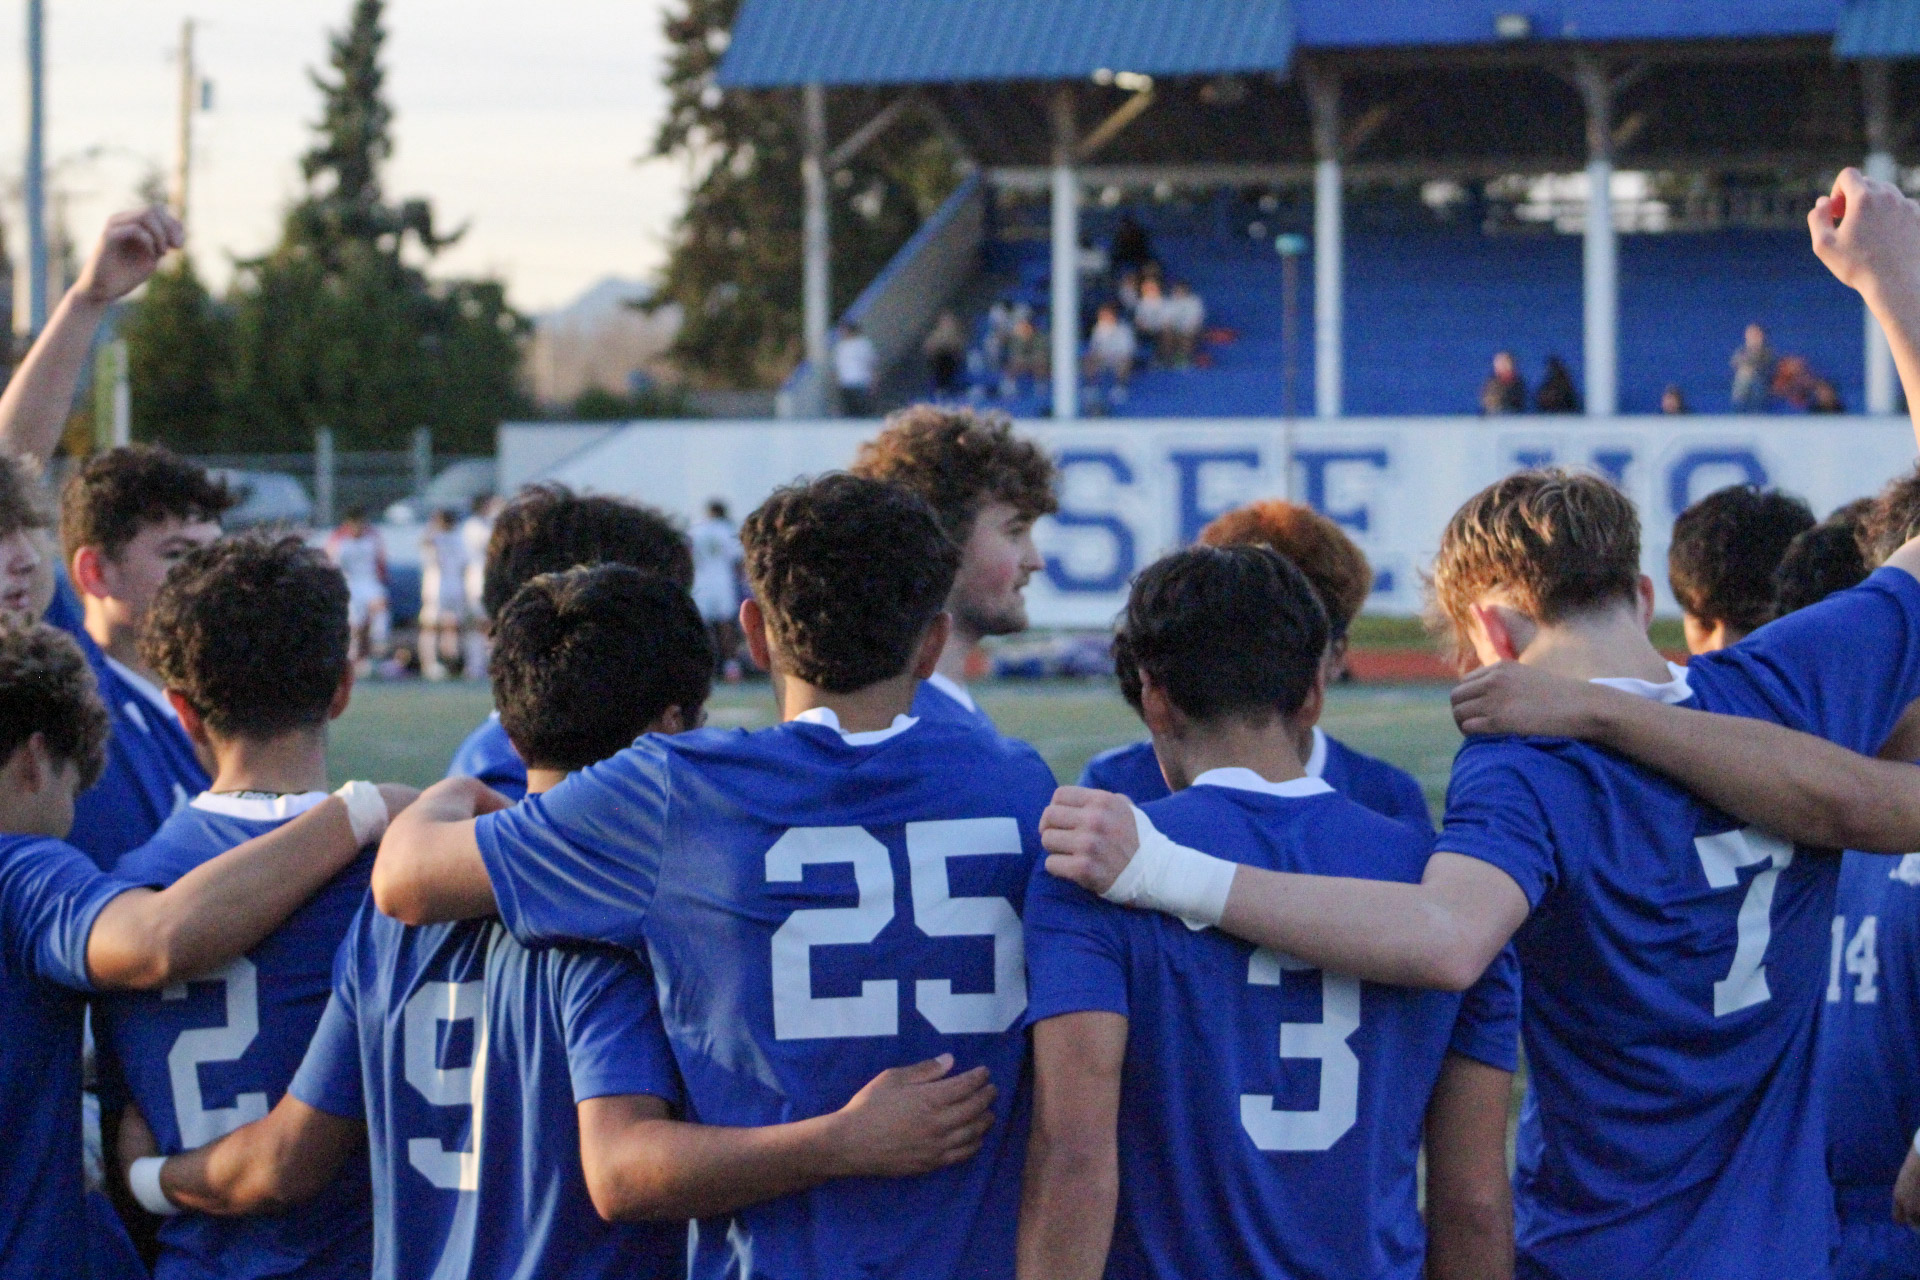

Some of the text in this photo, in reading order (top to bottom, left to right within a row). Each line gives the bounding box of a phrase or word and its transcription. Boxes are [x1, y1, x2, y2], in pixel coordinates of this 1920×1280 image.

[765, 817, 1028, 1040] 25
[1693, 829, 1795, 1017] 7
[1826, 915, 1879, 1003] 14
[161, 956, 269, 1149] 2
[404, 980, 488, 1191] 9
[1240, 949, 1361, 1150] 3
